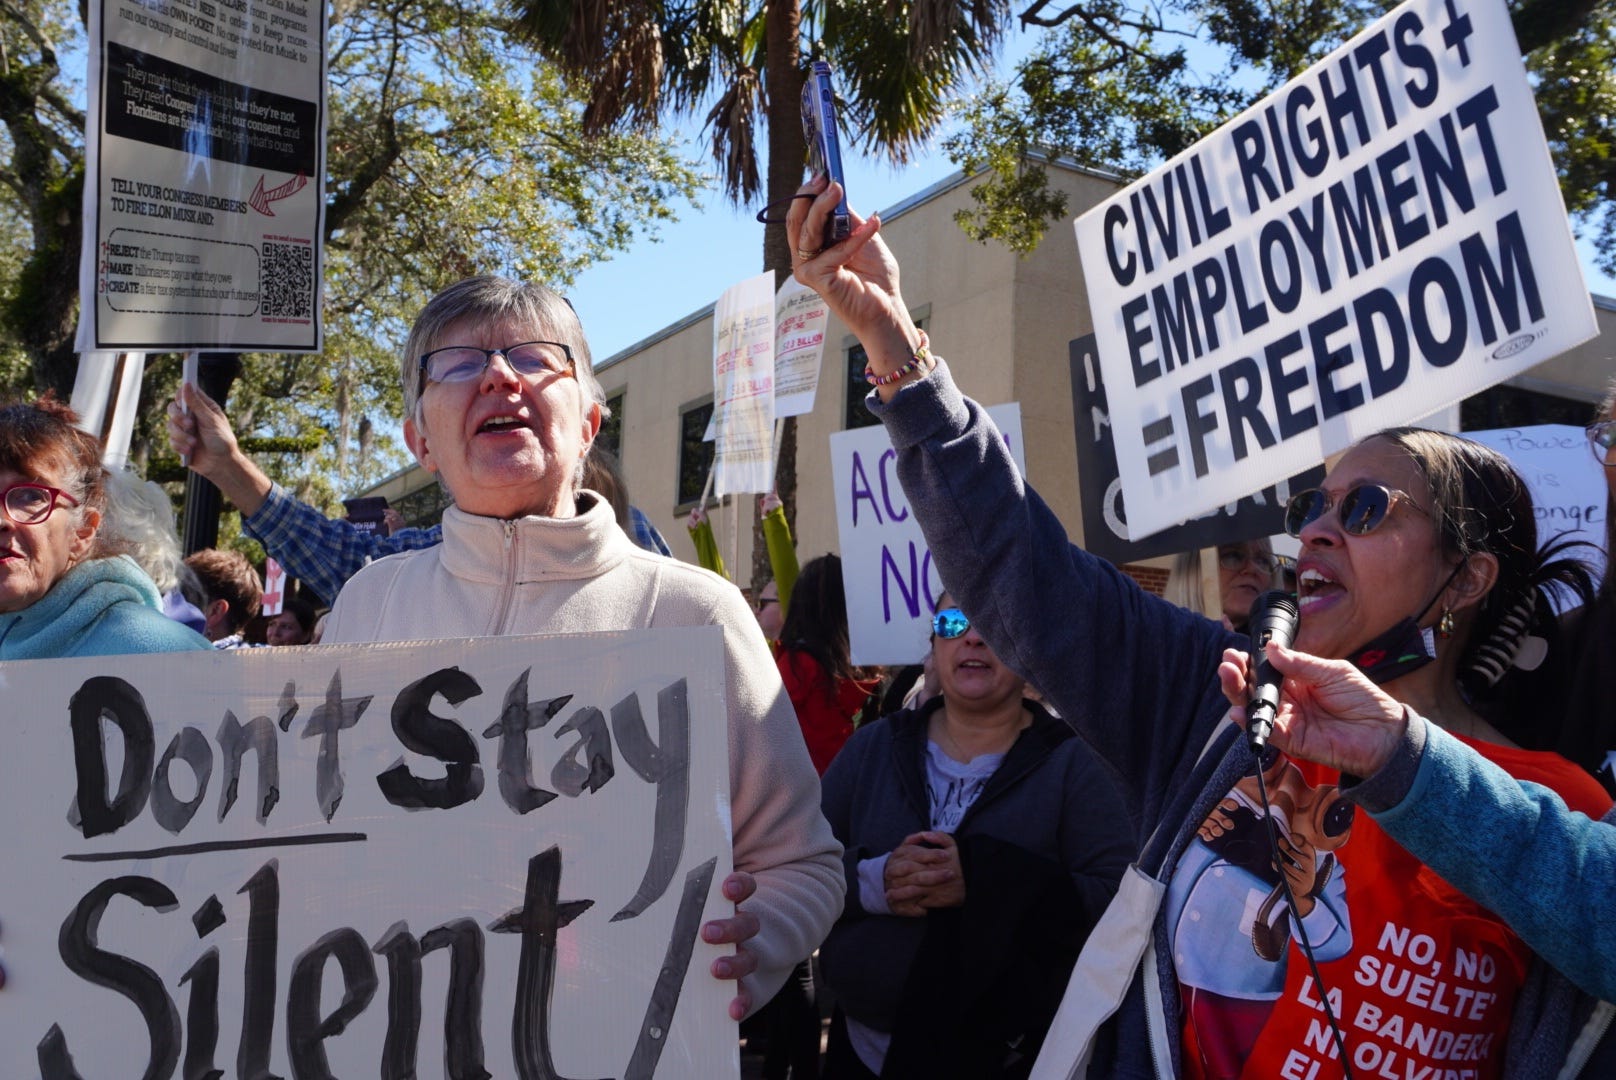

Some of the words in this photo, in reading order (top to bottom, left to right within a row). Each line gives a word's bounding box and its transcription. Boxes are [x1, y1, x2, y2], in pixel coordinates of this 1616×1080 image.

[119, 7, 134, 21] run
[135, 13, 147, 26] our
[174, 28, 186, 41] and
[270, 14, 307, 33] programs
[286, 1, 307, 17] Musk
[170, 6, 188, 23] OWN
[263, 40, 274, 55] for
[276, 44, 298, 61] Musk
[299, 52, 307, 63] to
[264, 25, 283, 43] keep
[287, 35, 307, 48] more
[122, 80, 144, 102] They
[232, 115, 247, 128] our
[283, 127, 301, 140] and
[126, 63, 147, 85] They
[234, 97, 248, 113] but
[249, 101, 280, 119] they're
[126, 99, 168, 123] Floridians
[168, 114, 180, 127] are
[206, 123, 223, 138] ack
[111, 177, 135, 195] TELL
[137, 182, 161, 200] YOUR
[163, 187, 203, 208] CONGRESS
[203, 194, 248, 214] MEMBERS
[111, 196, 125, 212] TO
[125, 199, 147, 216] FIRE
[148, 203, 172, 219] ELON
[172, 207, 197, 222] MUSK
[1103, 154, 1231, 287] CIVIL
[1121, 84, 1507, 389] EMPLOYMENT
[109, 243, 140, 258] REJECT
[140, 246, 152, 259] the
[152, 248, 174, 264] Trump
[109, 262, 133, 276] MAKE
[135, 263, 170, 278] billionaires
[109, 280, 140, 294] CREATE
[797, 333, 824, 347] BILLION
[67, 666, 374, 839] Don't
[376, 666, 691, 922] Stay
[1377, 921, 1442, 977] NO,
[1454, 947, 1496, 984] NO
[1297, 975, 1343, 1019] LA
[1353, 1001, 1495, 1061] BANDERA
[1303, 1018, 1347, 1060] NI
